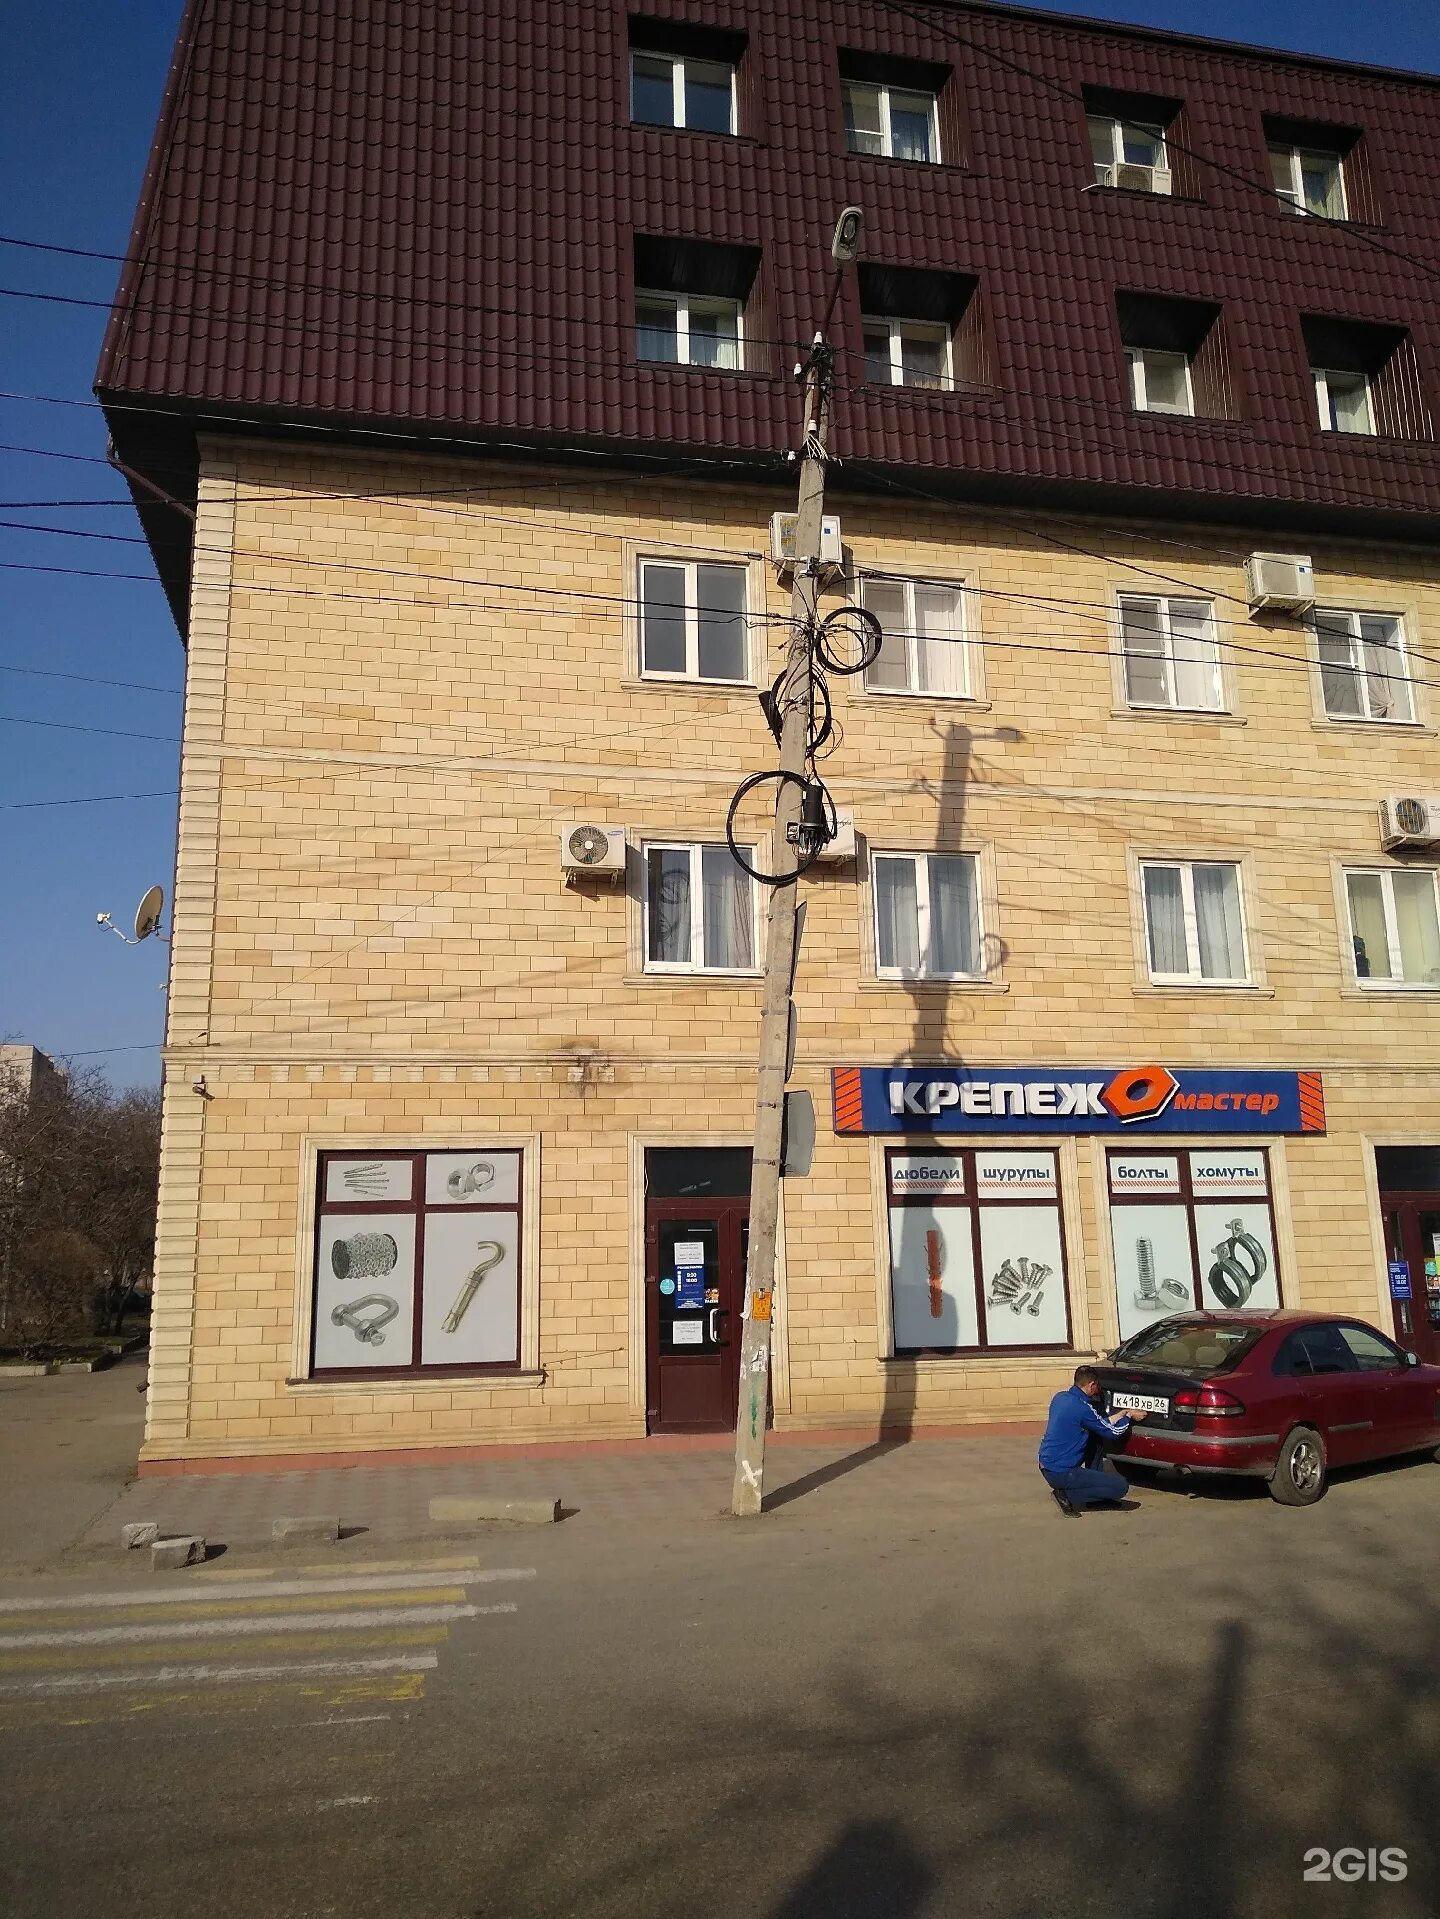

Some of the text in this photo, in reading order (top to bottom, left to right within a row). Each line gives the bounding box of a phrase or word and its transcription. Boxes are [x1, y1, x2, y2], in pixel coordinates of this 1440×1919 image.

[889, 1082, 1280, 1115] КРЕПЕЖ мастер
[894, 1167, 960, 1180] дюбели
[983, 1168, 1050, 1181] шурупы
[1118, 1166, 1169, 1179] болты
[1197, 1167, 1259, 1179] хомуты
